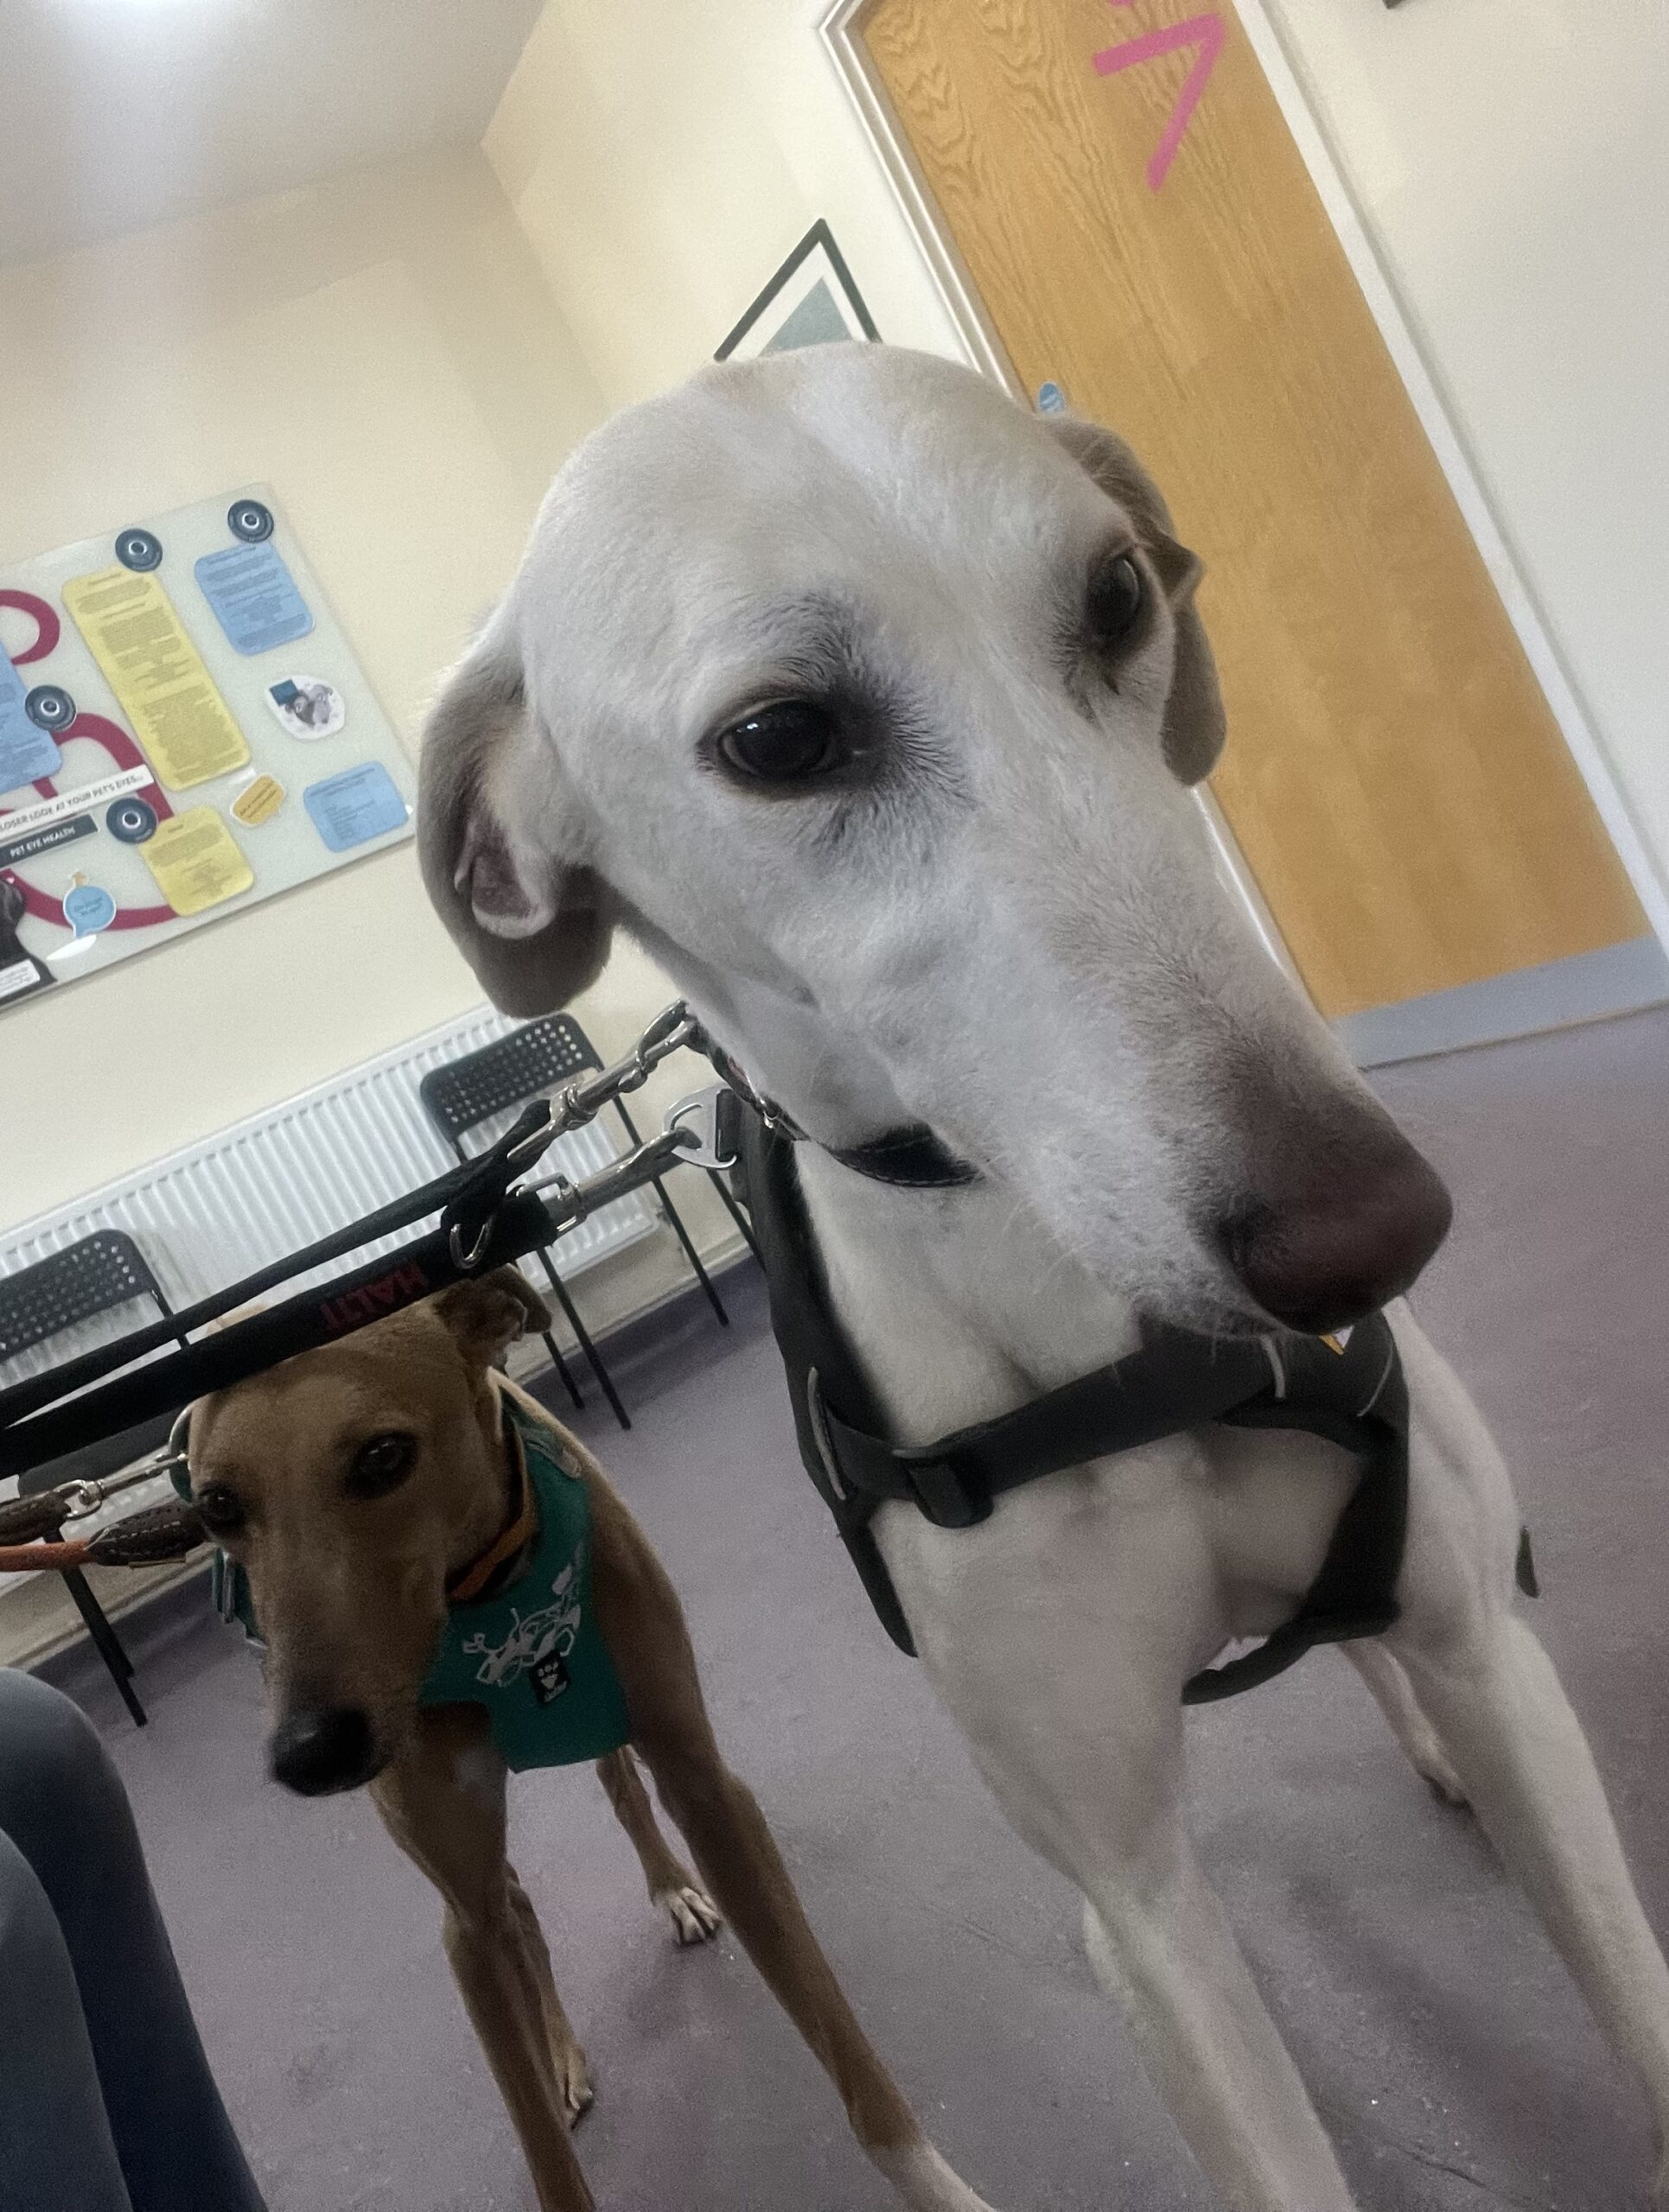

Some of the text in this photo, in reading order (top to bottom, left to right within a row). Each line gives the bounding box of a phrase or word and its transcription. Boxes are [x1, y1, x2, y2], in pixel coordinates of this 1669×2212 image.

[29, 807, 53, 821] LOOK
[56, 801, 66, 811] AT
[67, 791, 91, 804] YOUR
[10, 827, 76, 858] PET EYE HEALTH
